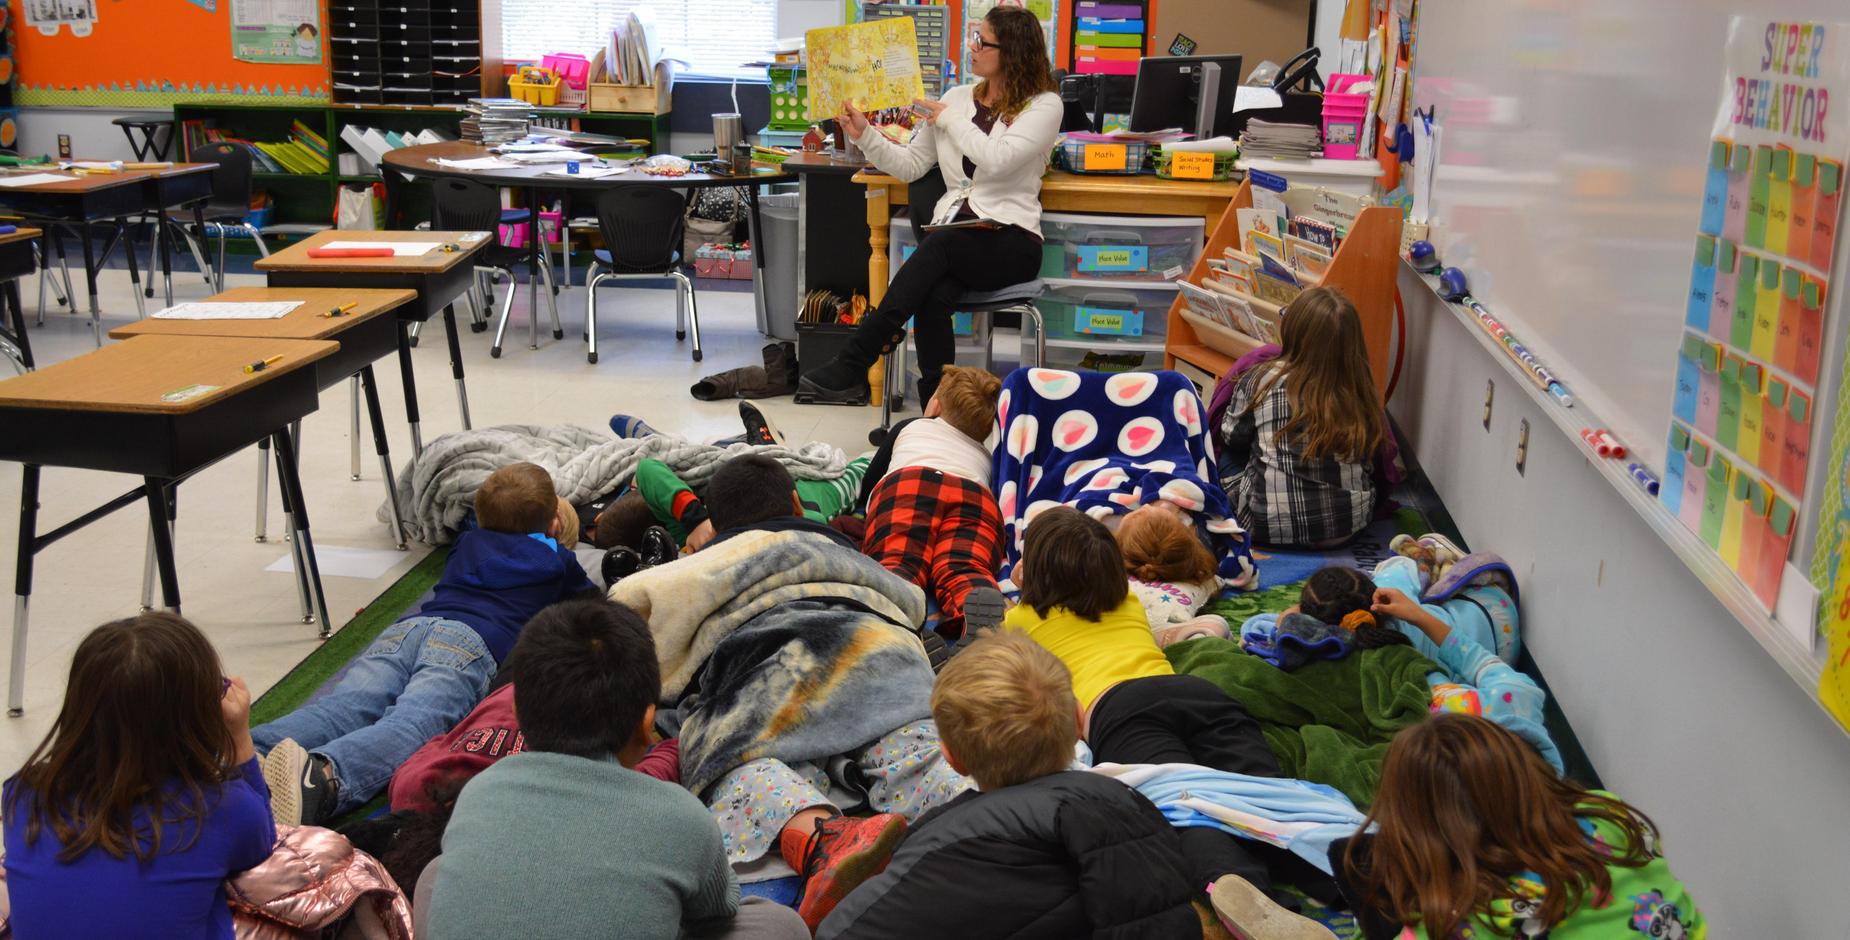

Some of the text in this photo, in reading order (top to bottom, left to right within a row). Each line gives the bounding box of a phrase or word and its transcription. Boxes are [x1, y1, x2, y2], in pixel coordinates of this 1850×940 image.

[1761, 22, 1825, 78] SUPER
[1731, 76, 1829, 143] BEHAVIOR
[1094, 151, 1115, 159] Math
[1323, 193, 1338, 205] The
[1313, 203, 1356, 220] Gingerbrea
[1098, 255, 1112, 263] Place
[1091, 317, 1121, 326] Place Value
